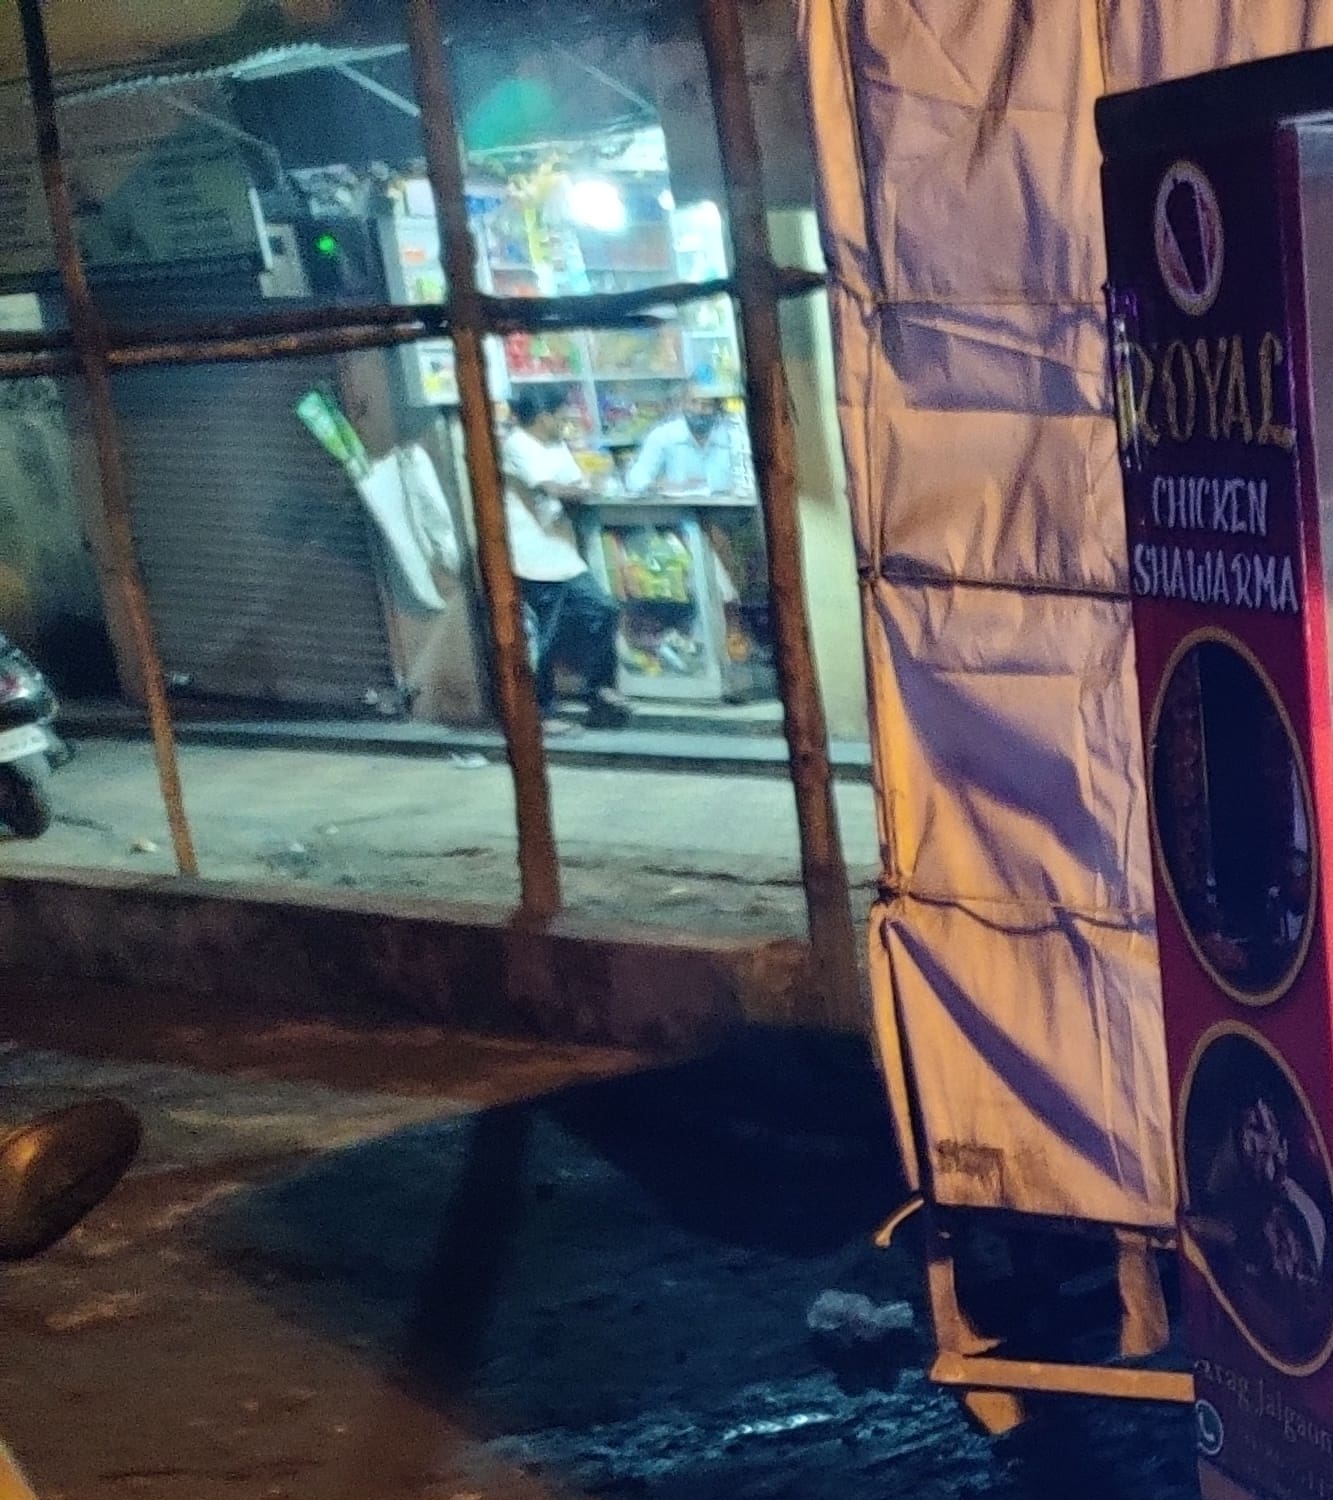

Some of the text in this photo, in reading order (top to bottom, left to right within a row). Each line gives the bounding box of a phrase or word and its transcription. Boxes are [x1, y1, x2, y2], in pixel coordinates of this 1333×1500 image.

[1118, 330, 1297, 450] ROYAL
[1151, 474, 1269, 537] CHICKEN
[1132, 544, 1299, 613] SHAWARMA
